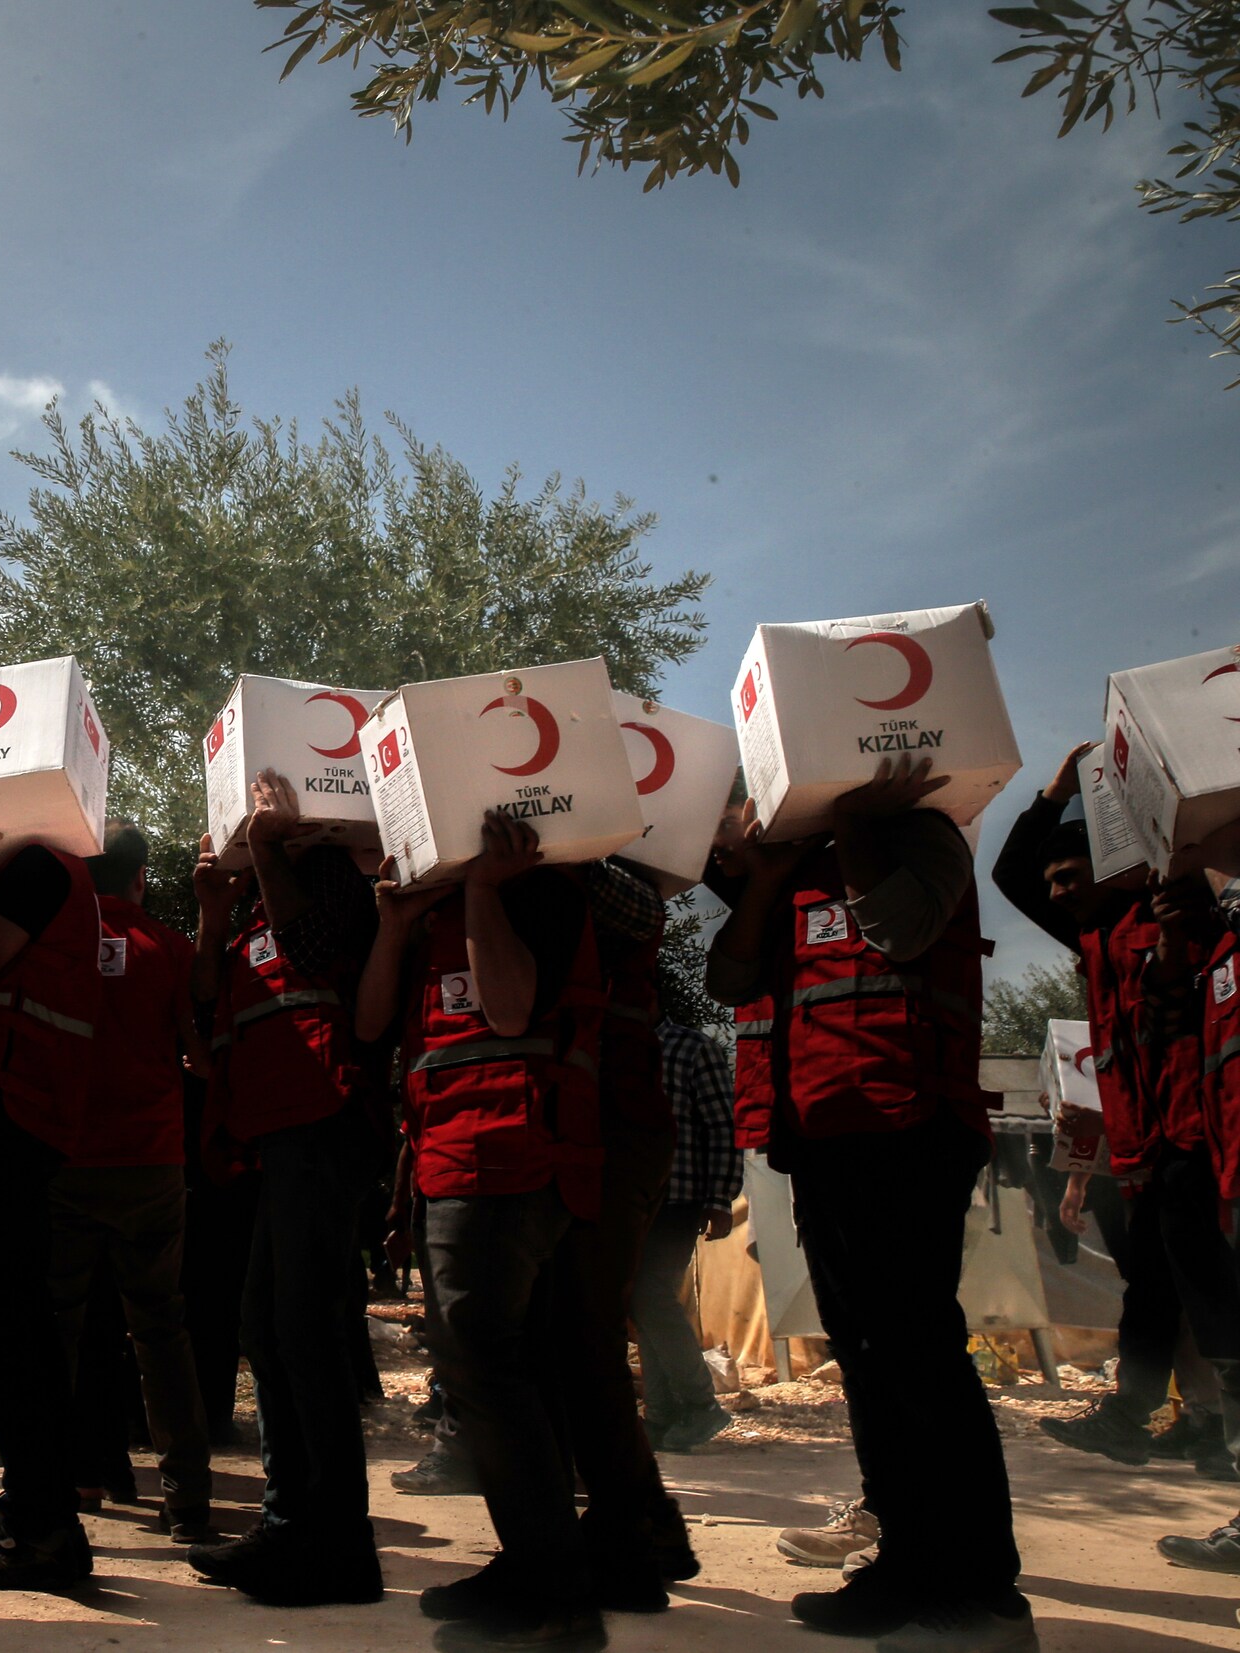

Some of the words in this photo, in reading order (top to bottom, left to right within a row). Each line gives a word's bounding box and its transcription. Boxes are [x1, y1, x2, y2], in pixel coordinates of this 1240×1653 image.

[879, 720, 918, 732] TÜRK
[858, 730, 943, 753] KIZILAY
[324, 767, 354, 778] TÜRK
[305, 777, 370, 795] KIZILAY
[516, 785, 551, 798] TÜRK
